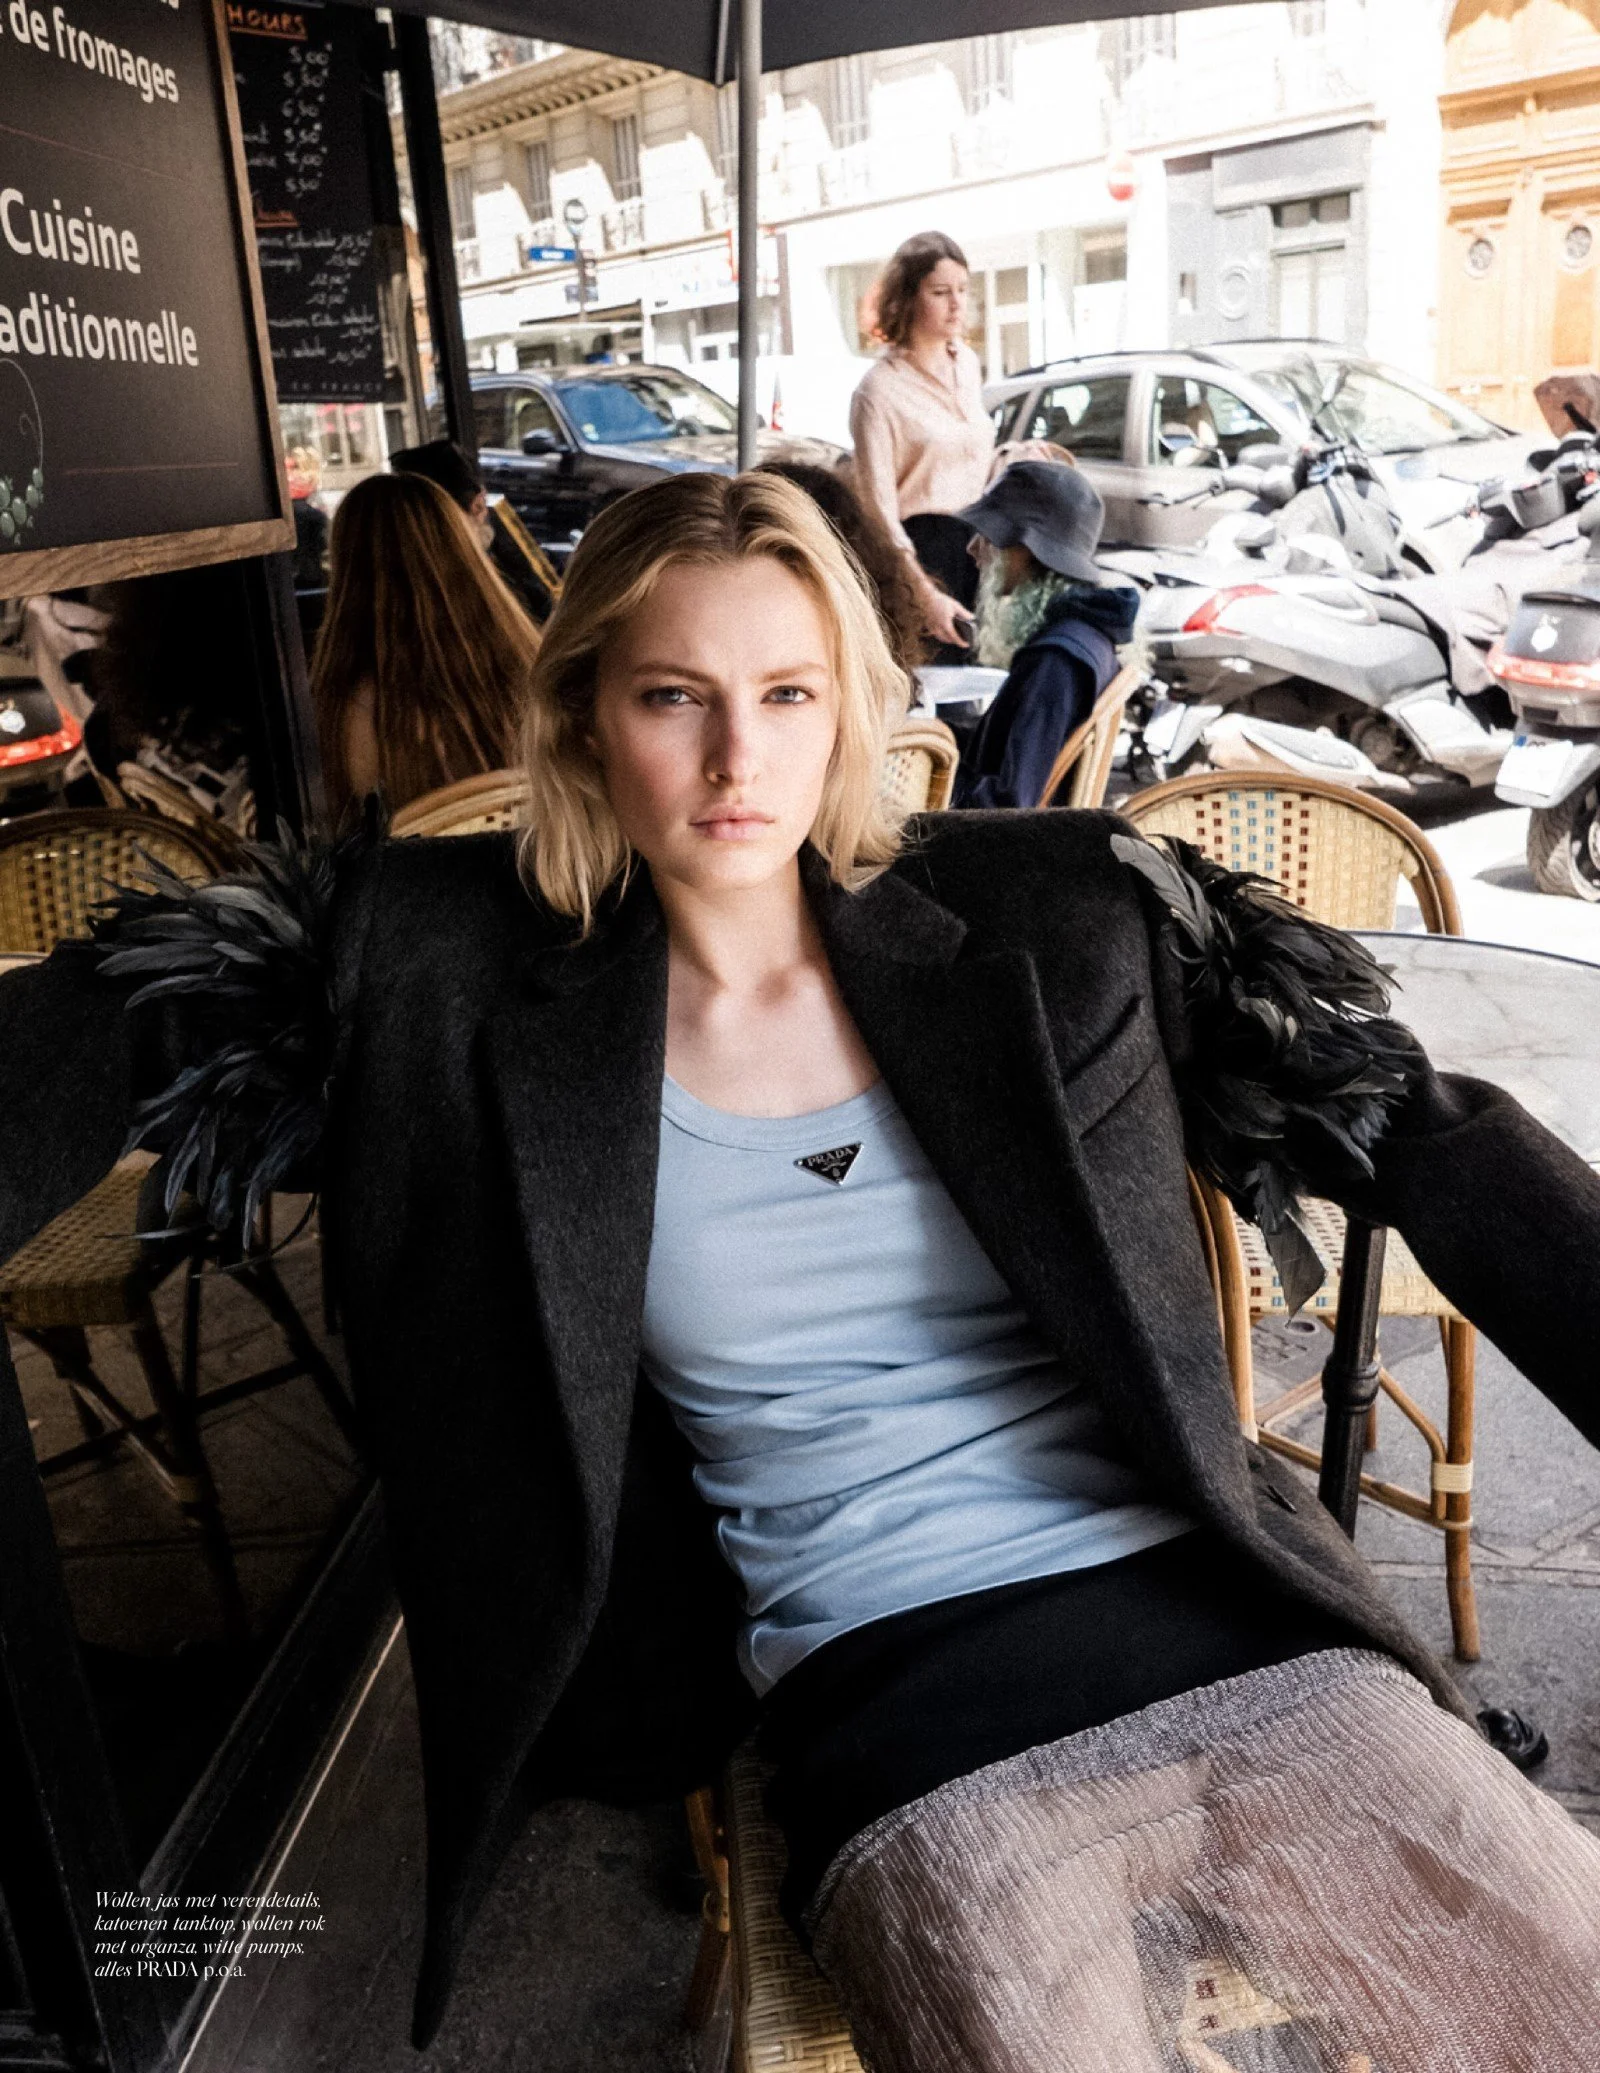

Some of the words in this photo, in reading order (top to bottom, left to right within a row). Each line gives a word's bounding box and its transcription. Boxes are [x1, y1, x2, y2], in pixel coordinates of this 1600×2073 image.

[9, 0, 50, 52] de
[52, 6, 179, 103] fromages
[227, 3, 306, 34] HOURS
[0, 188, 141, 274] Cuisine
[0, 291, 199, 367] aditionnelle
[807, 1147, 855, 1167] PRADA
